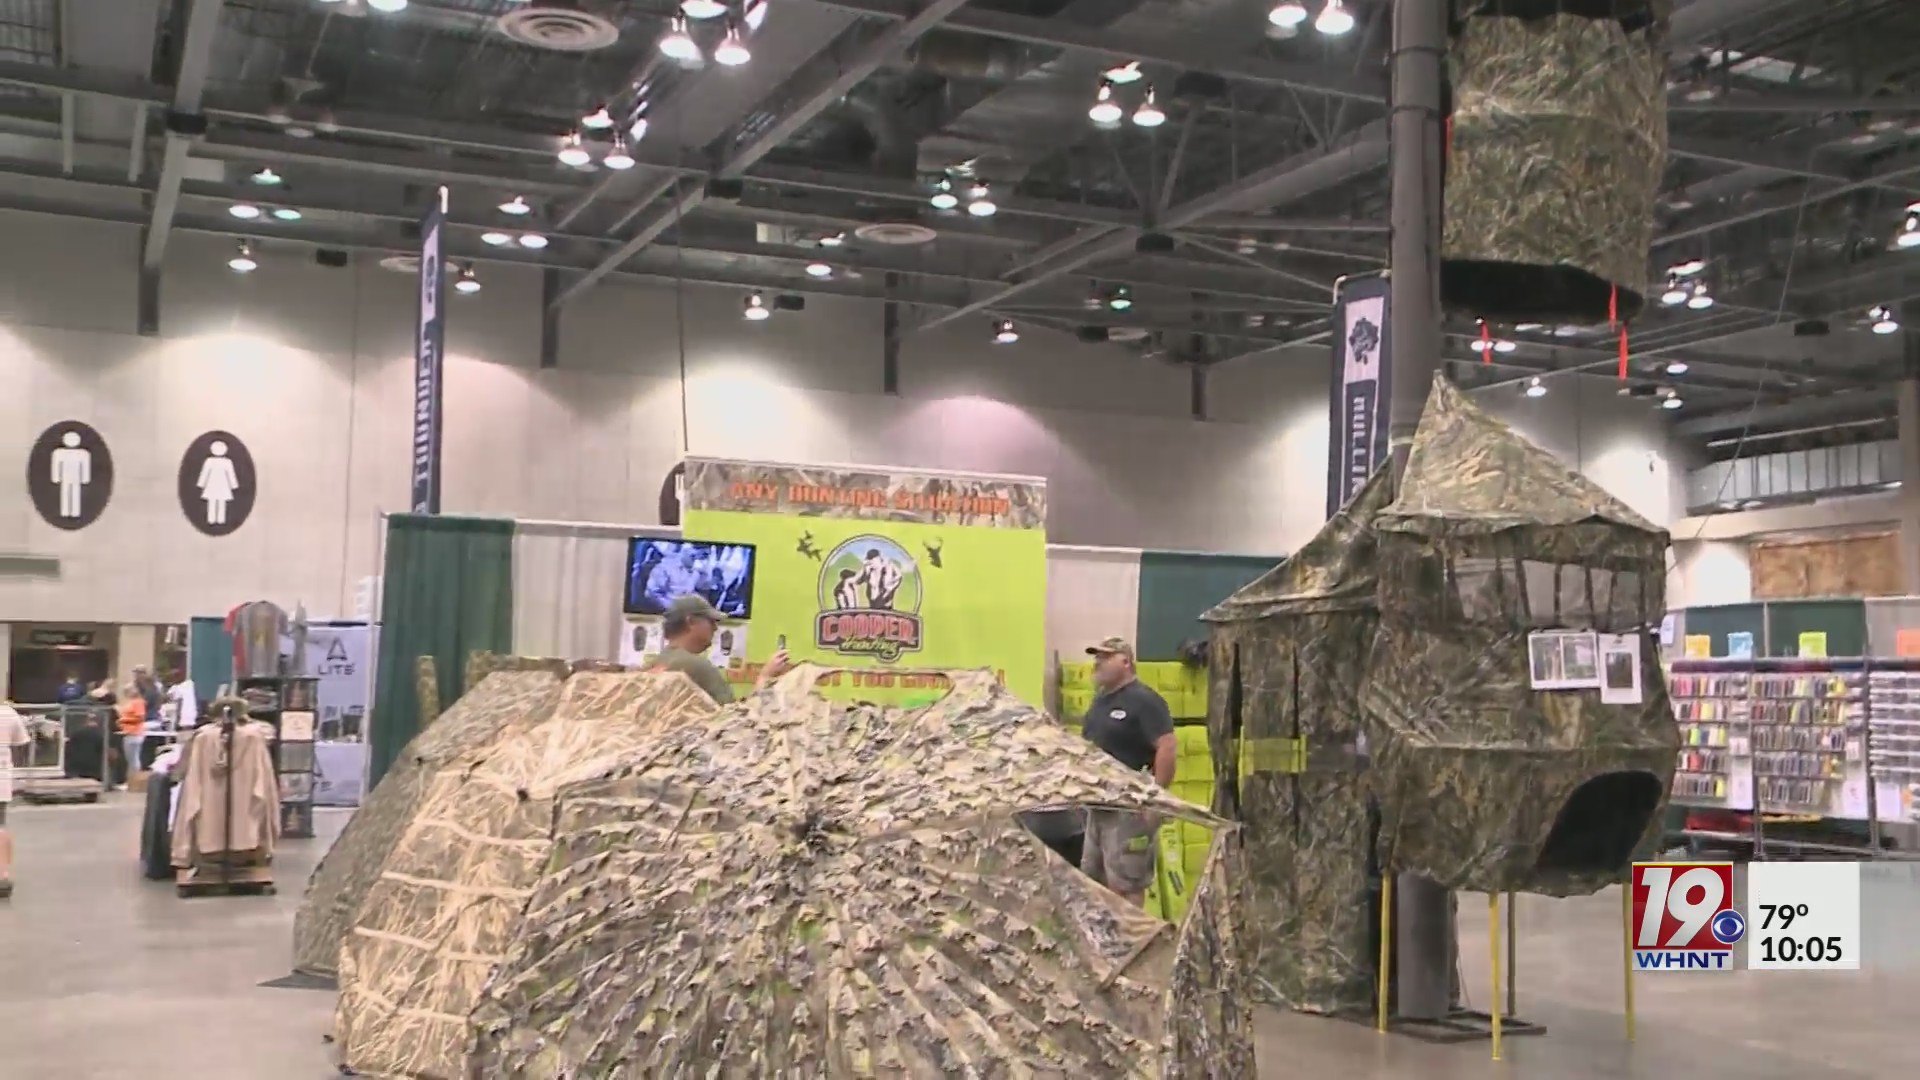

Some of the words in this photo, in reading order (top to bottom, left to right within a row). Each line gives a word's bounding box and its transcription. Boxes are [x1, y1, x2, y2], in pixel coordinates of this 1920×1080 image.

[730, 480, 778, 500] ANY
[822, 614, 917, 645] COOPER
[841, 635, 900, 657] Hunting
